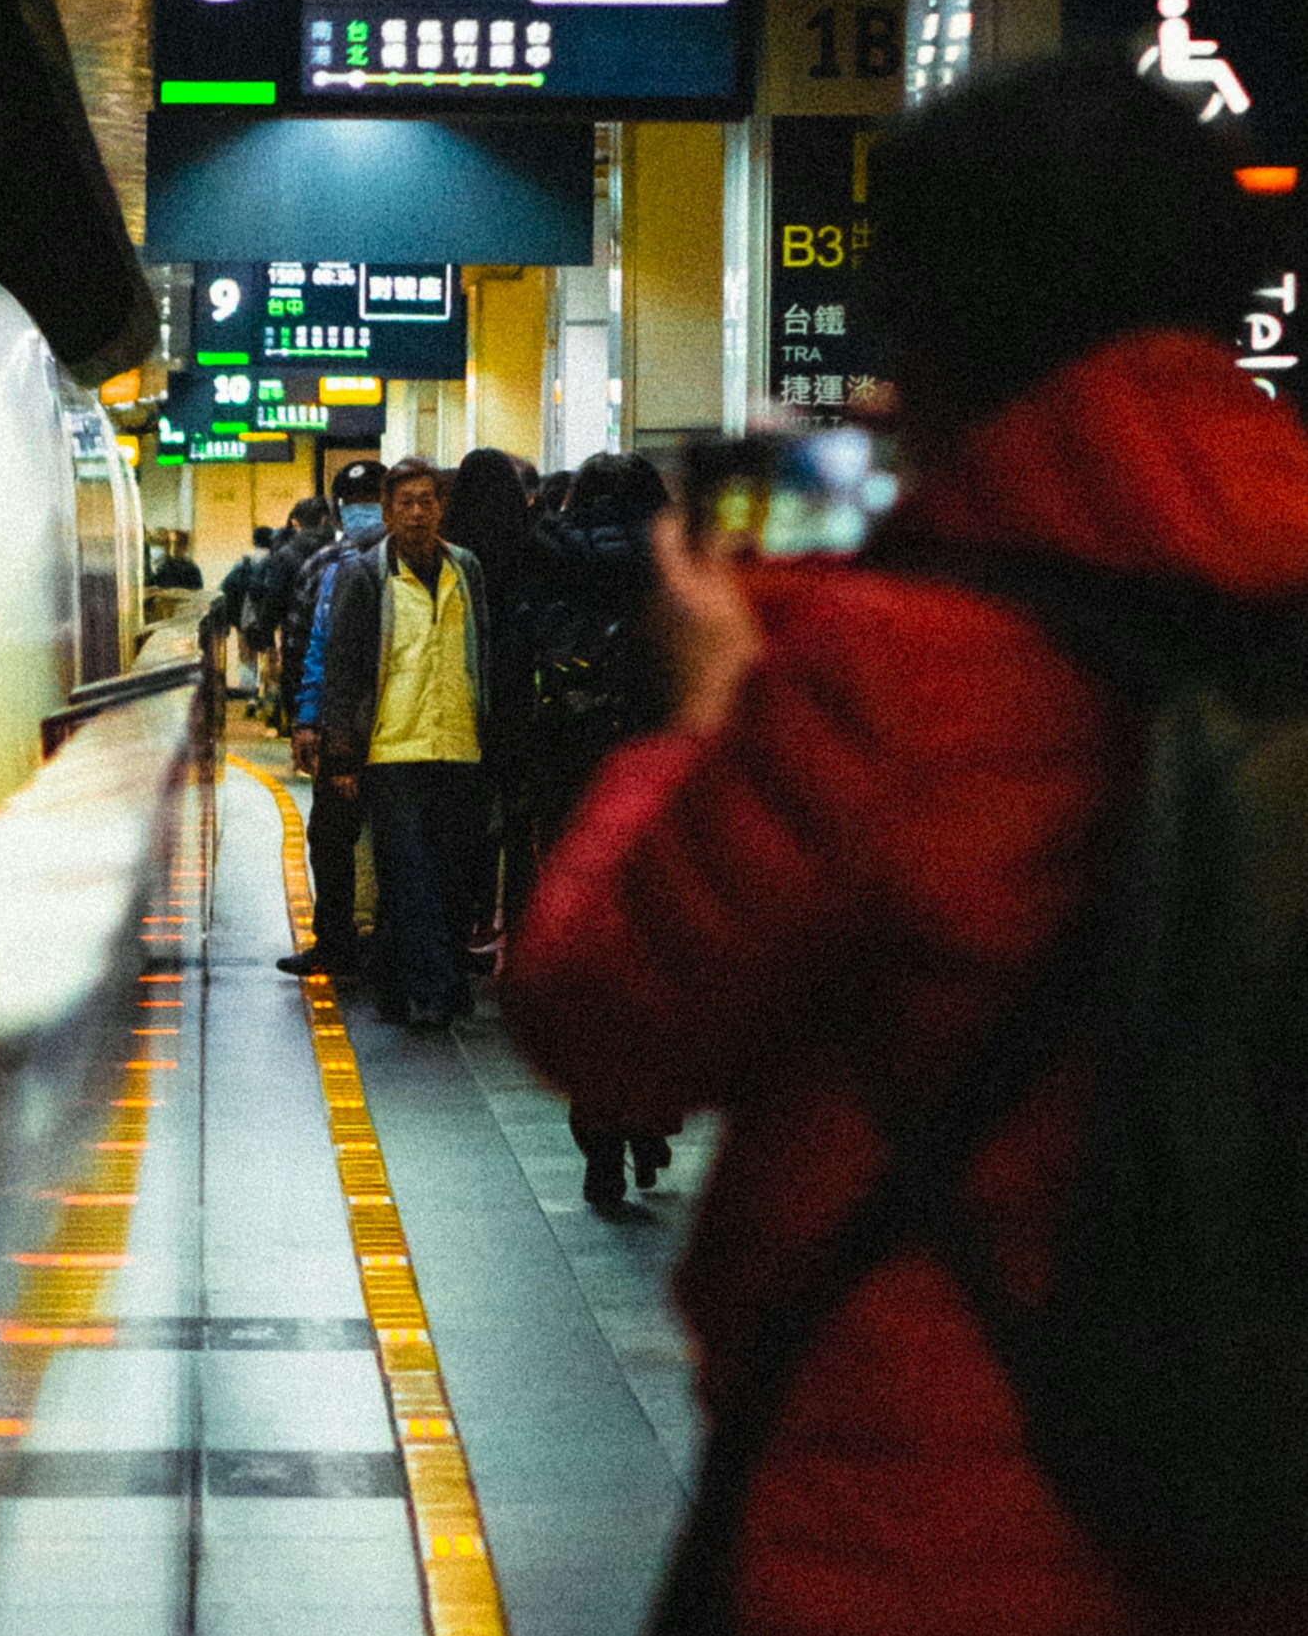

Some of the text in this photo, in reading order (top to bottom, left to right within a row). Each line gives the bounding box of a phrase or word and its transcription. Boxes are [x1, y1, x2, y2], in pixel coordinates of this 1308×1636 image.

[807, 6, 900, 78] 1B
[783, 224, 845, 267] B3
[209, 278, 241, 322] 9
[784, 303, 846, 336] 台鐵
[782, 346, 822, 362] TRA
